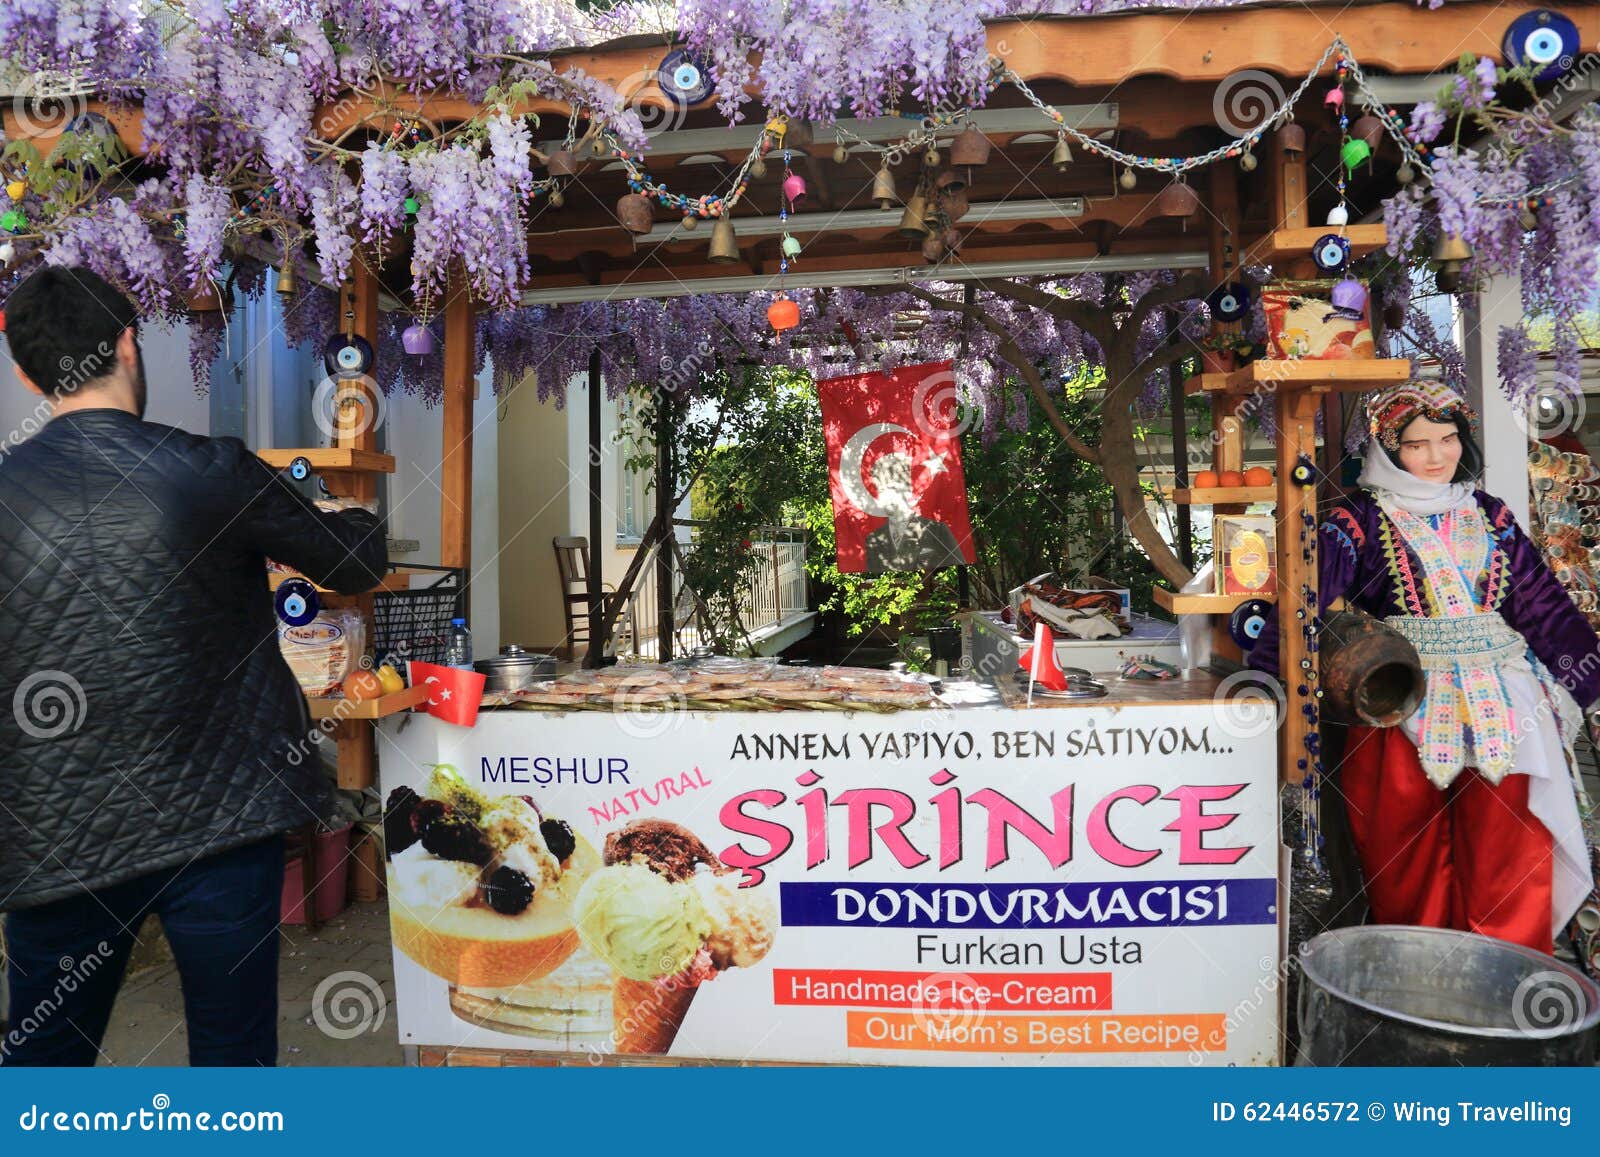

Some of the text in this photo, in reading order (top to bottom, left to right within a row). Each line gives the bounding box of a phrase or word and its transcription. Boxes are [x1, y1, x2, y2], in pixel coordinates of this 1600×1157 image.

[730, 732, 850, 760] ANNEM
[859, 731, 981, 760] YAPIYO,
[992, 730, 1055, 758] BEN
[480, 756, 631, 788] MEŞHUR
[588, 765, 712, 826] NATURAL
[718, 768, 1255, 889] ŞİRİNCE
[831, 885, 1228, 924] DONDURMACISI
[917, 935, 1142, 965] Furkan Usta
[791, 976, 1097, 1005] Handmade Ice-Cream
[866, 1017, 917, 1041] Our
[1028, 1021, 1092, 1045] Best
[1101, 1020, 1200, 1048] Recipe
